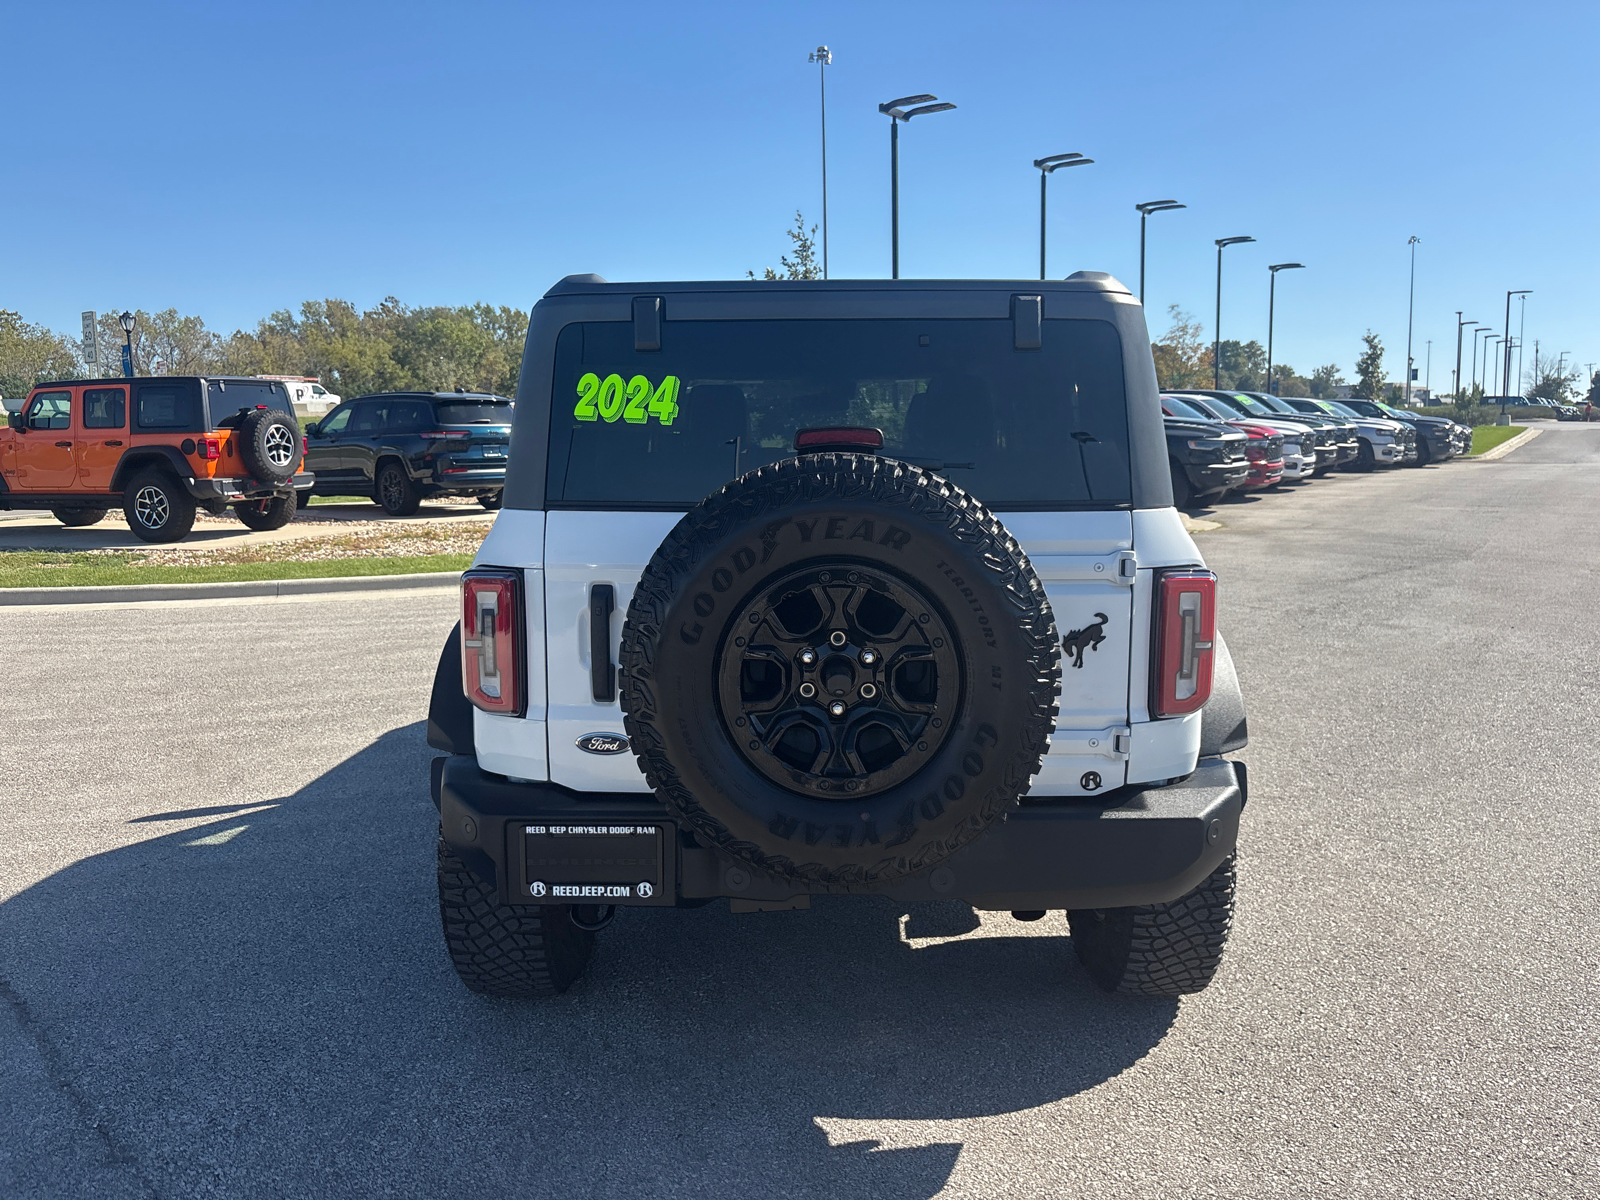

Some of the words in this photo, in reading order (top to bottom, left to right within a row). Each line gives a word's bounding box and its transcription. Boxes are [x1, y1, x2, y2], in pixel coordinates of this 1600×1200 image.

[574, 372, 681, 426] 2024
[679, 514, 912, 646] GOODYEAR
[936, 559, 998, 650] TERRITORY
[588, 737, 620, 751] Ford
[525, 826, 546, 834] REED
[568, 826, 608, 834] CHRYSLER
[609, 826, 635, 834] DODGE
[636, 826, 656, 835] RAM
[552, 886, 630, 896] REEDJEEP.COM
